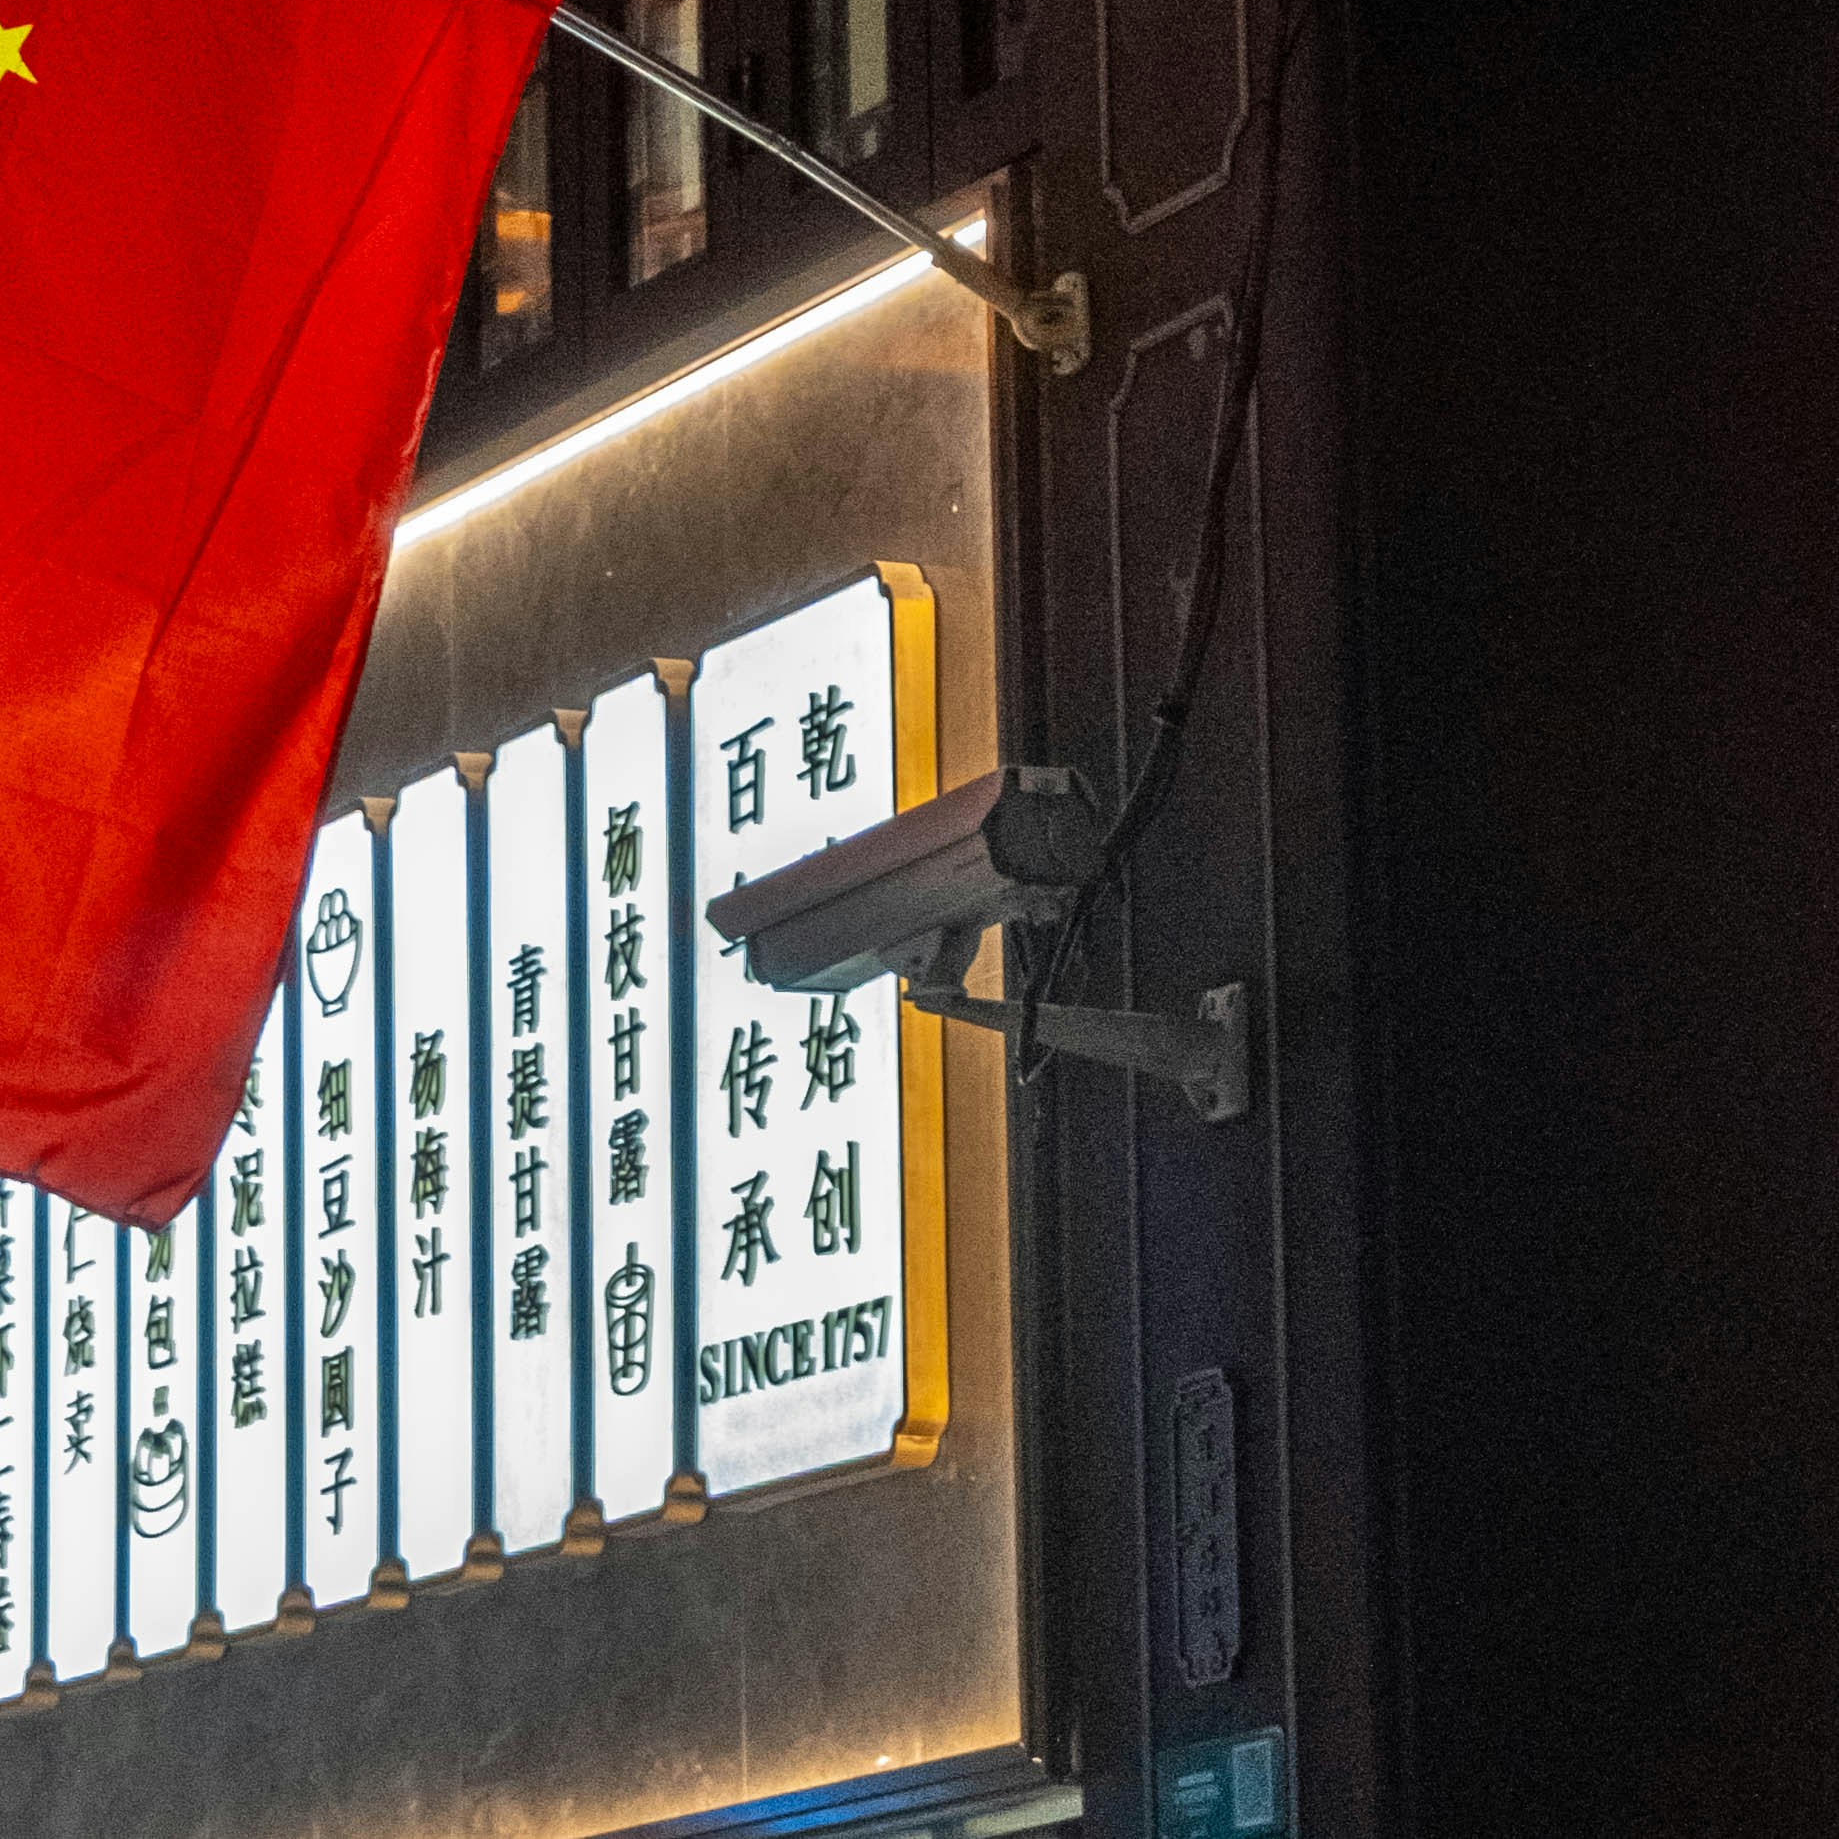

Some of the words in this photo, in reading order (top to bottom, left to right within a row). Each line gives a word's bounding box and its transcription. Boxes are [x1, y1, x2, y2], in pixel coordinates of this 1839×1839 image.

[507, 944, 549, 1341] 青提甘露
[602, 801, 648, 1206] 杨枝甘露
[796, 685, 860, 1257] 乾始创
[318, 1058, 357, 1536] 细豆沙圆子
[410, 1029, 451, 1319] 杨梅汁
[700, 1319, 816, 1406] SINCE
[821, 1296, 893, 1373] 1757
